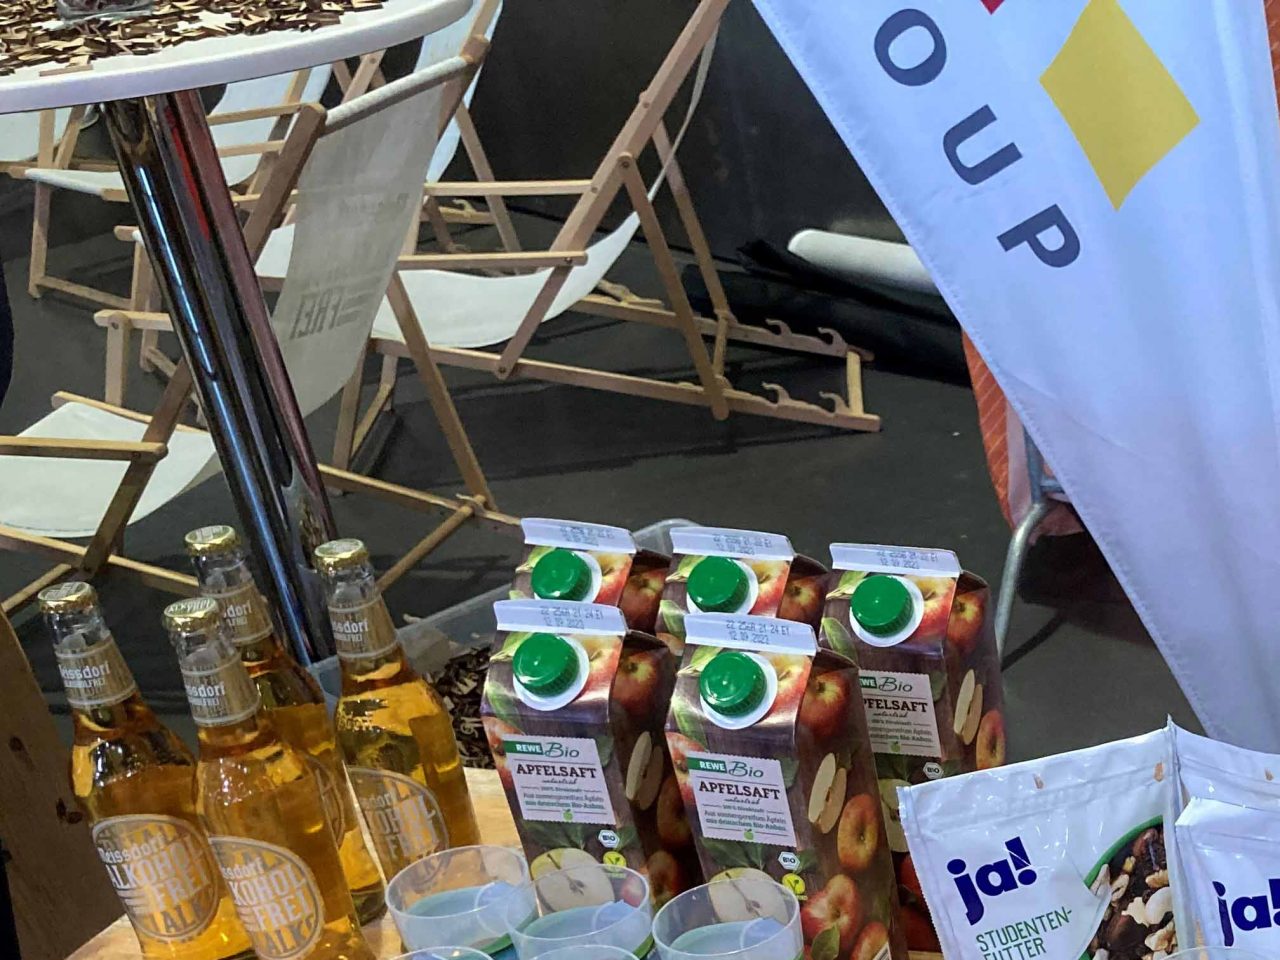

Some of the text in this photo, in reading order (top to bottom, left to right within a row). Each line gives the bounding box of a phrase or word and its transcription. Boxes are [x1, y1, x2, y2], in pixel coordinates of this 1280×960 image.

[878, 676, 912, 692] Bio
[515, 742, 580, 758] REWE Bio
[516, 763, 597, 779] APFELSAFT
[699, 760, 764, 778] REWE Bio
[699, 781, 781, 800] APFELSAFT
[105, 835, 204, 890] ALKOHOL
[947, 836, 1037, 926] ja!
[976, 906, 1073, 952] STUDENTEN-
